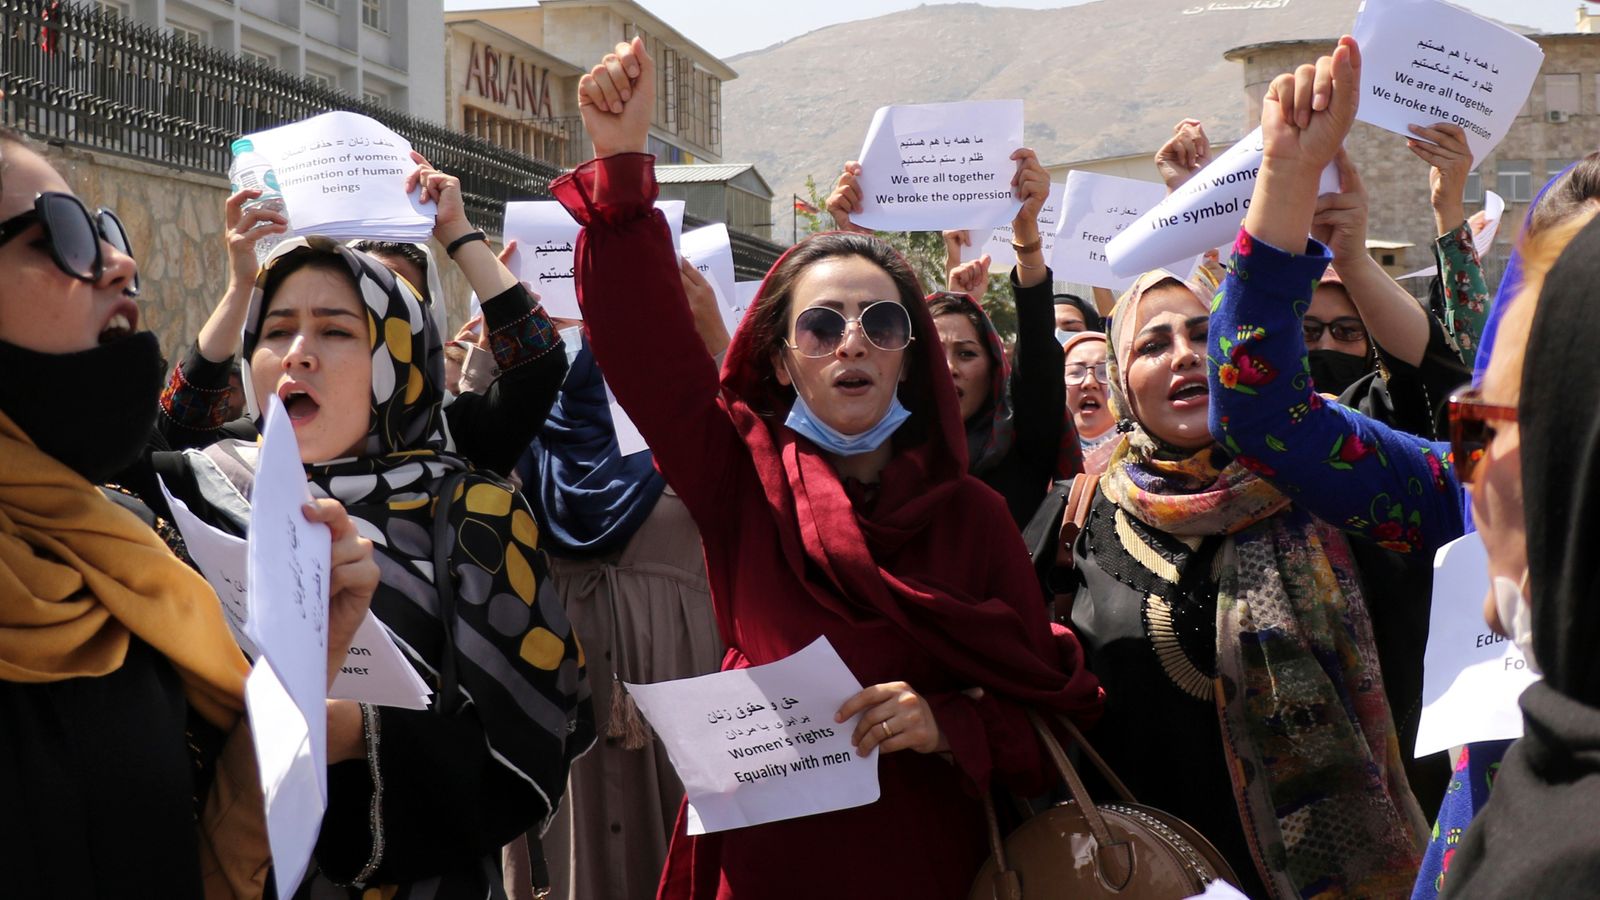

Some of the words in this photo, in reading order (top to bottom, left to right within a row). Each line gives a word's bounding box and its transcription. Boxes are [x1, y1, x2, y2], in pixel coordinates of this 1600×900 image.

[1416, 39, 1445, 53] هستیم
[1448, 50, 1460, 59] هم
[1464, 52, 1470, 64] با
[1473, 58, 1488, 70] همه
[1491, 64, 1499, 75] ما
[465, 41, 552, 121] ARIANA
[1452, 70, 1469, 82] ستم
[1472, 80, 1478, 88] و
[1479, 81, 1493, 93] ظلم
[1395, 71, 1414, 85] We
[1416, 79, 1436, 93] are
[1438, 85, 1453, 98] all
[1455, 92, 1494, 117] together
[1372, 85, 1391, 100] We
[1393, 94, 1427, 112] broke
[1430, 105, 1449, 119] the
[1452, 114, 1492, 140] oppression
[348, 137, 369, 147] زنان
[900, 137, 925, 149] هستیم
[929, 138, 940, 149] هم
[943, 136, 951, 146] با
[954, 137, 970, 145] همه
[974, 135, 984, 144] ما
[278, 158, 336, 174] limination
[339, 153, 351, 163] of
[901, 154, 937, 168] شکستیم
[939, 154, 956, 167] ستم
[960, 156, 966, 164] و
[968, 152, 984, 163] ظلم
[347, 167, 359, 176] of
[362, 167, 403, 176] human
[891, 175, 910, 184] We
[912, 175, 930, 184] are
[933, 172, 945, 183] all
[948, 171, 996, 185] together
[1212, 167, 1258, 187] wome
[322, 184, 361, 193] beings
[876, 194, 894, 204] We
[897, 192, 928, 203] broke
[931, 191, 949, 202] the
[952, 190, 1012, 202] oppression
[1183, 198, 1238, 224] symbol
[1243, 198, 1250, 209] o
[1082, 231, 1112, 244] Freed
[535, 240, 573, 259] هستیم
[1089, 250, 1098, 261] It
[539, 267, 575, 285] کستیم
[1476, 632, 1504, 648] Edu
[1504, 657, 1525, 671] Fo
[771, 701, 778, 711] و
[781, 697, 799, 710] حق
[707, 709, 732, 724] زنان
[735, 702, 765, 719] حقوق
[726, 727, 757, 740] مردان
[756, 723, 771, 732] با
[728, 737, 793, 760] Women's
[795, 727, 835, 744] rights
[734, 763, 787, 784] Equality
[790, 757, 819, 772] with
[822, 751, 851, 766] men
